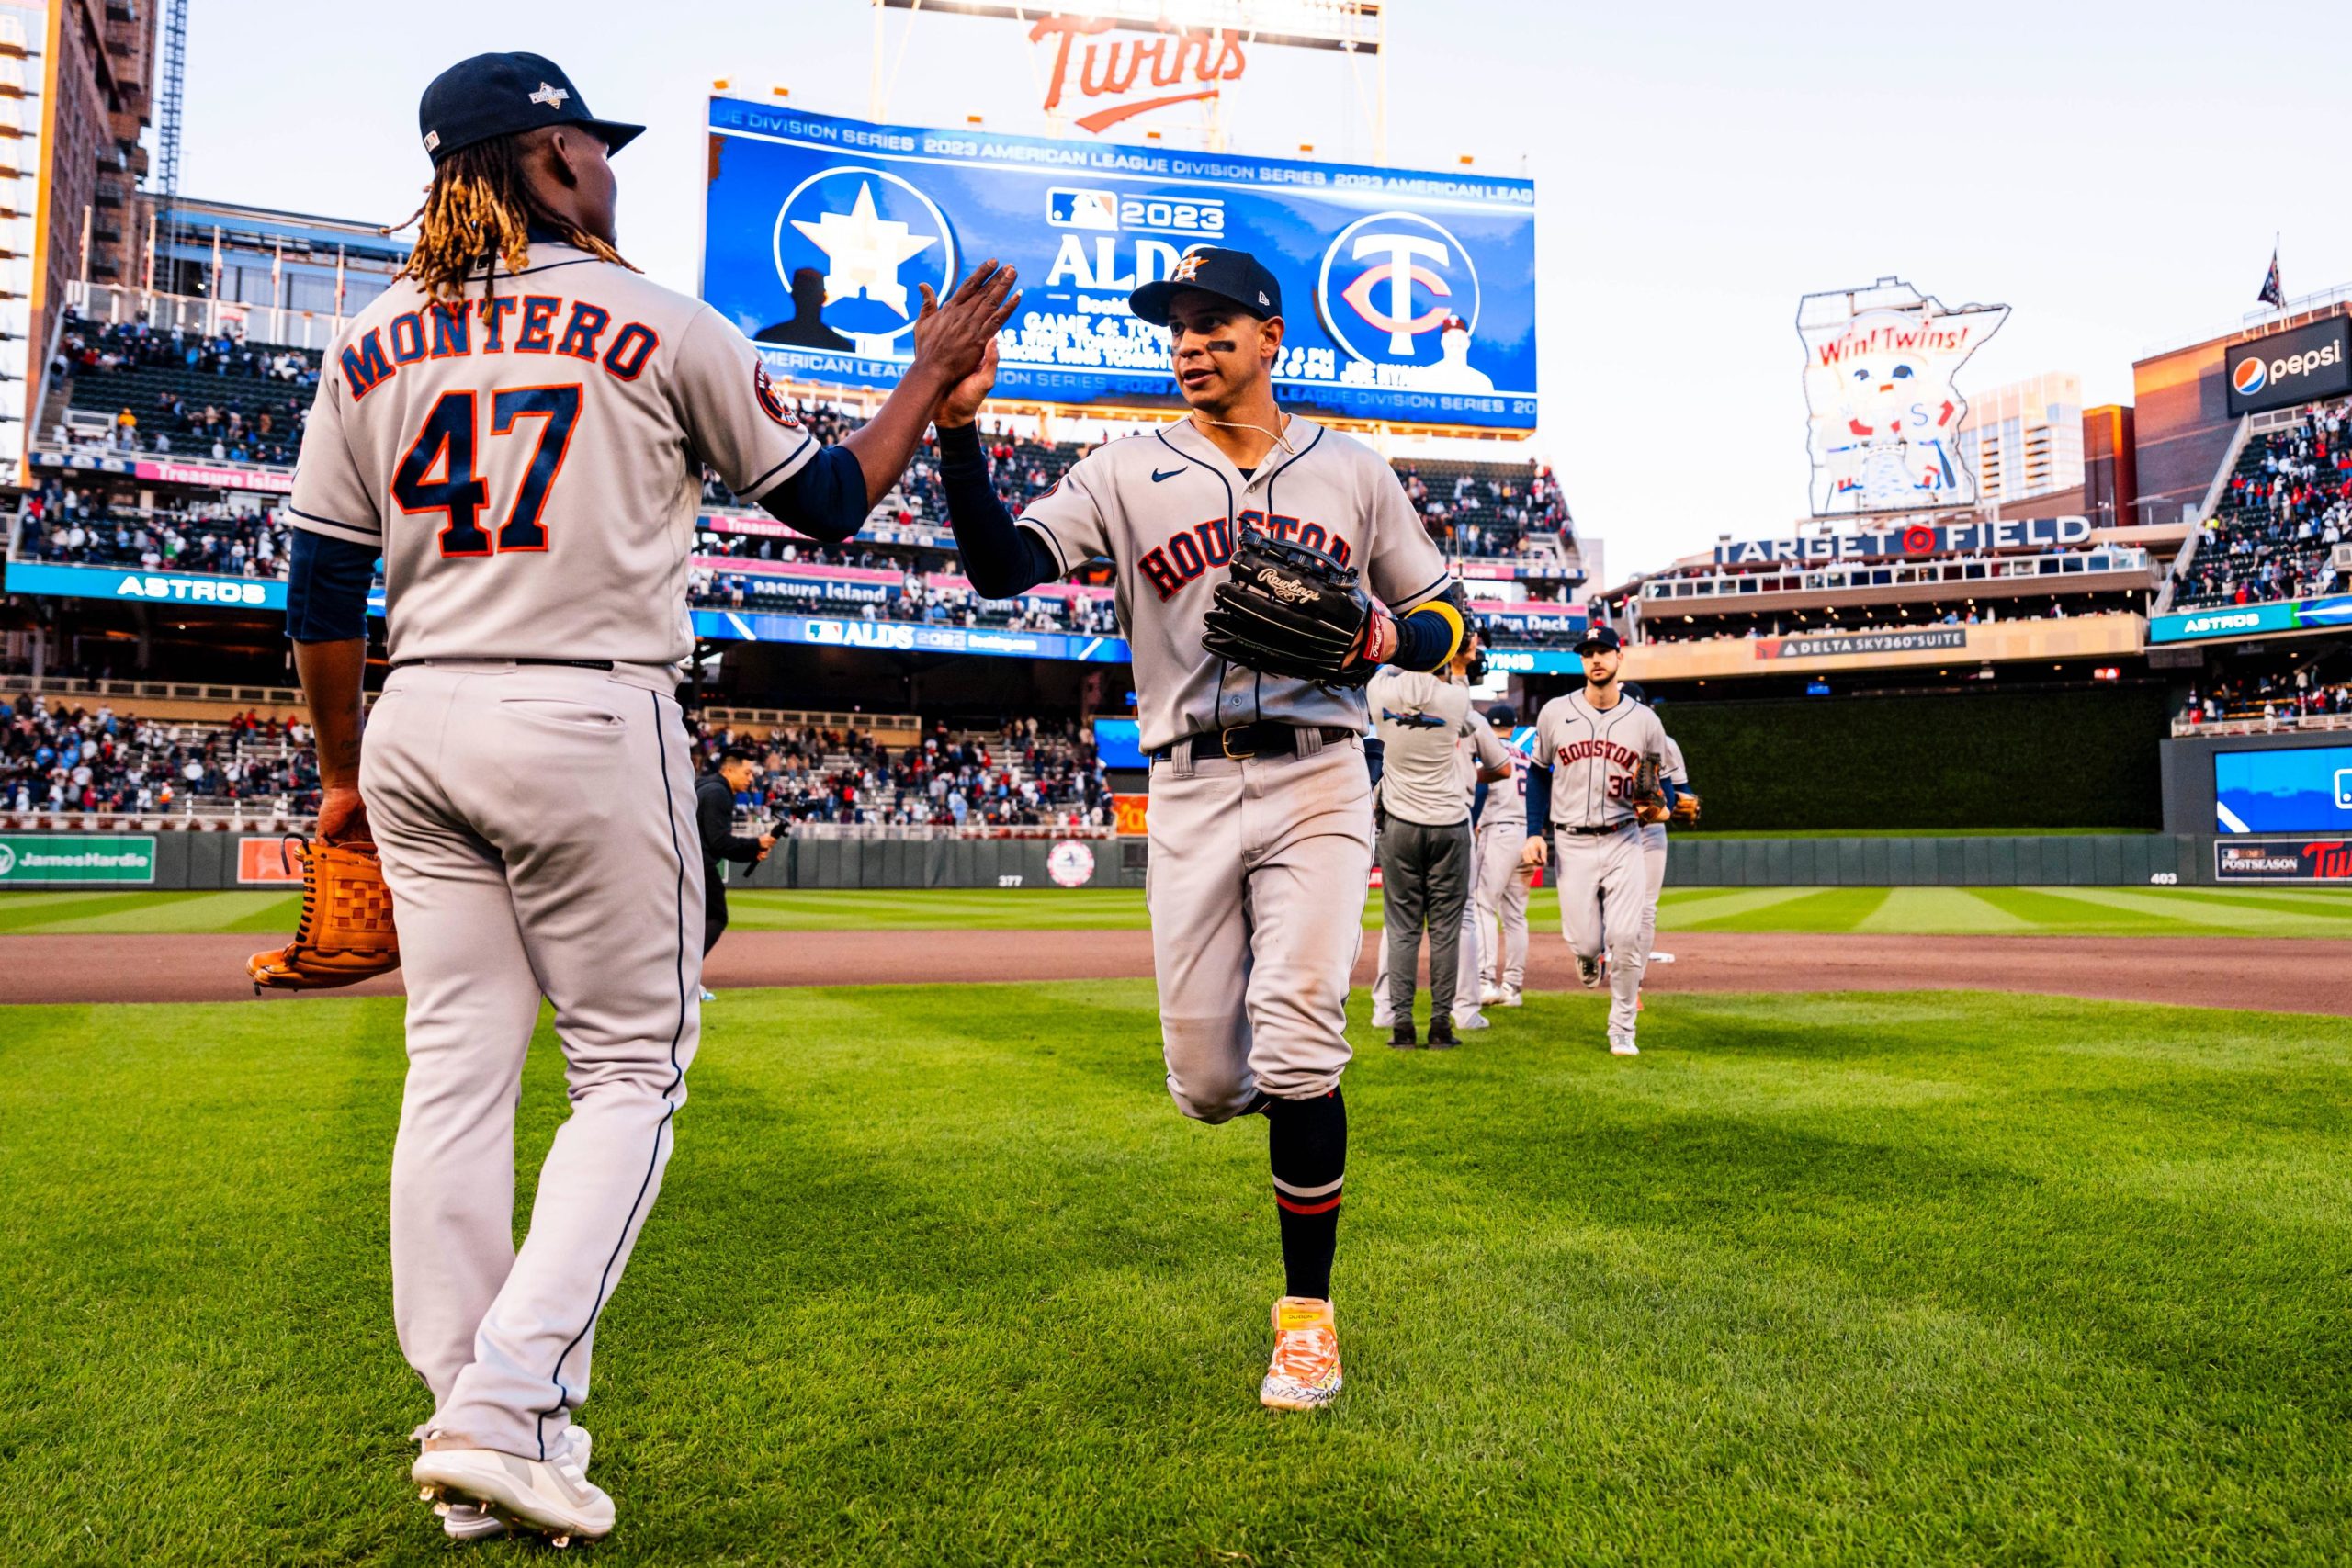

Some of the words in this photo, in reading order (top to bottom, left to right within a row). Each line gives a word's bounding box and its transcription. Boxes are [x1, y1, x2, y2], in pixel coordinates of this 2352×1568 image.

[1029, 15, 1246, 110] Twins
[749, 112, 837, 141] DIVISION
[842, 130, 915, 152] SERIES
[923, 140, 978, 158] 2023
[980, 142, 1088, 167] AMERICAN
[1091, 151, 1168, 174] LEAGUE
[1172, 158, 1255, 180] DIVISION
[1259, 166, 1326, 186] SERIES
[1334, 172, 1385, 190] 2023
[1385, 176, 1484, 198] AMERICAN
[1120, 201, 1225, 231] 2023
[1023, 311, 1091, 333] GAME
[338, 295, 660, 402] MONTERO
[1820, 329, 1877, 367] Win!
[1883, 326, 1968, 351] Twins!
[759, 349, 853, 374] MERICAN
[857, 364, 916, 378] LEAG
[2270, 339, 2342, 385] pepsi
[1036, 372, 1107, 390] SERIES
[1357, 392, 1436, 410] DIVISION
[1440, 398, 1506, 413] SERIES
[155, 463, 242, 487] Treasure
[390, 382, 583, 558] 47
[726, 517, 792, 537] Treasure
[1718, 530, 1895, 563] TARGET
[1946, 515, 2091, 551] FIELD
[117, 576, 266, 604] ASTROS
[753, 581, 821, 599] easure
[826, 582, 888, 603] Island
[1257, 568, 1321, 604] Rawlings
[843, 621, 916, 649] ALDS
[1527, 615, 1570, 632] Deck
[2185, 613, 2260, 633] ASTROS
[1800, 638, 1852, 654] DELTA
[1917, 632, 1962, 647] SUITE
[1557, 739, 1639, 770] HOUSTON
[1608, 775, 1634, 799] 30
[19, 852, 149, 867] JamesHardie
[2222, 858, 2298, 870] POSTSEASON
[998, 875, 1023, 887] 377
[2151, 873, 2177, 885] 403
